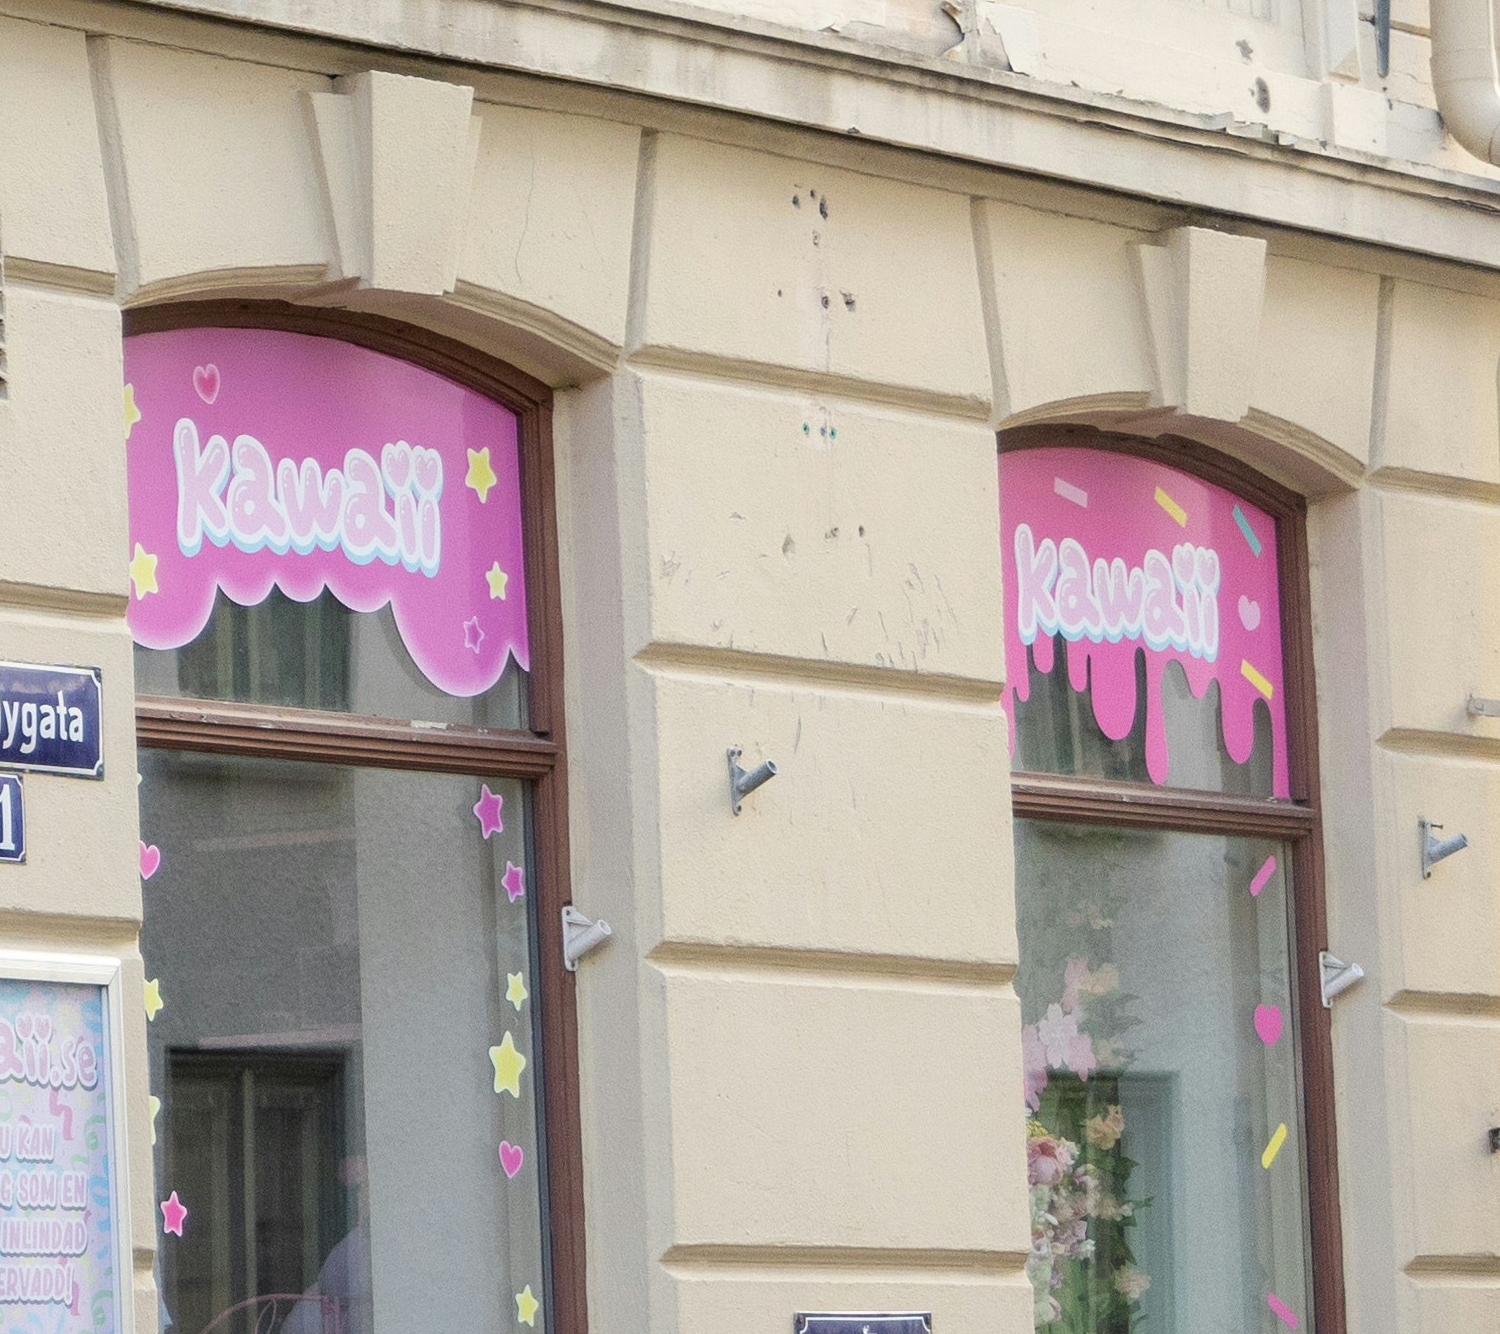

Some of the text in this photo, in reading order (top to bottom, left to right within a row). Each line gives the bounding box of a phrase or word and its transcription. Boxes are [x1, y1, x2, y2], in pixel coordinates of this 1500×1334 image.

[173, 418, 443, 577] kawaii
[1014, 523, 1220, 662] kawaii
[16, 1123, 55, 1163] KAN
[17, 1171, 57, 1210] SOM
[61, 1172, 87, 1210] EN
[0, 1218, 87, 1257] INLINDAD
